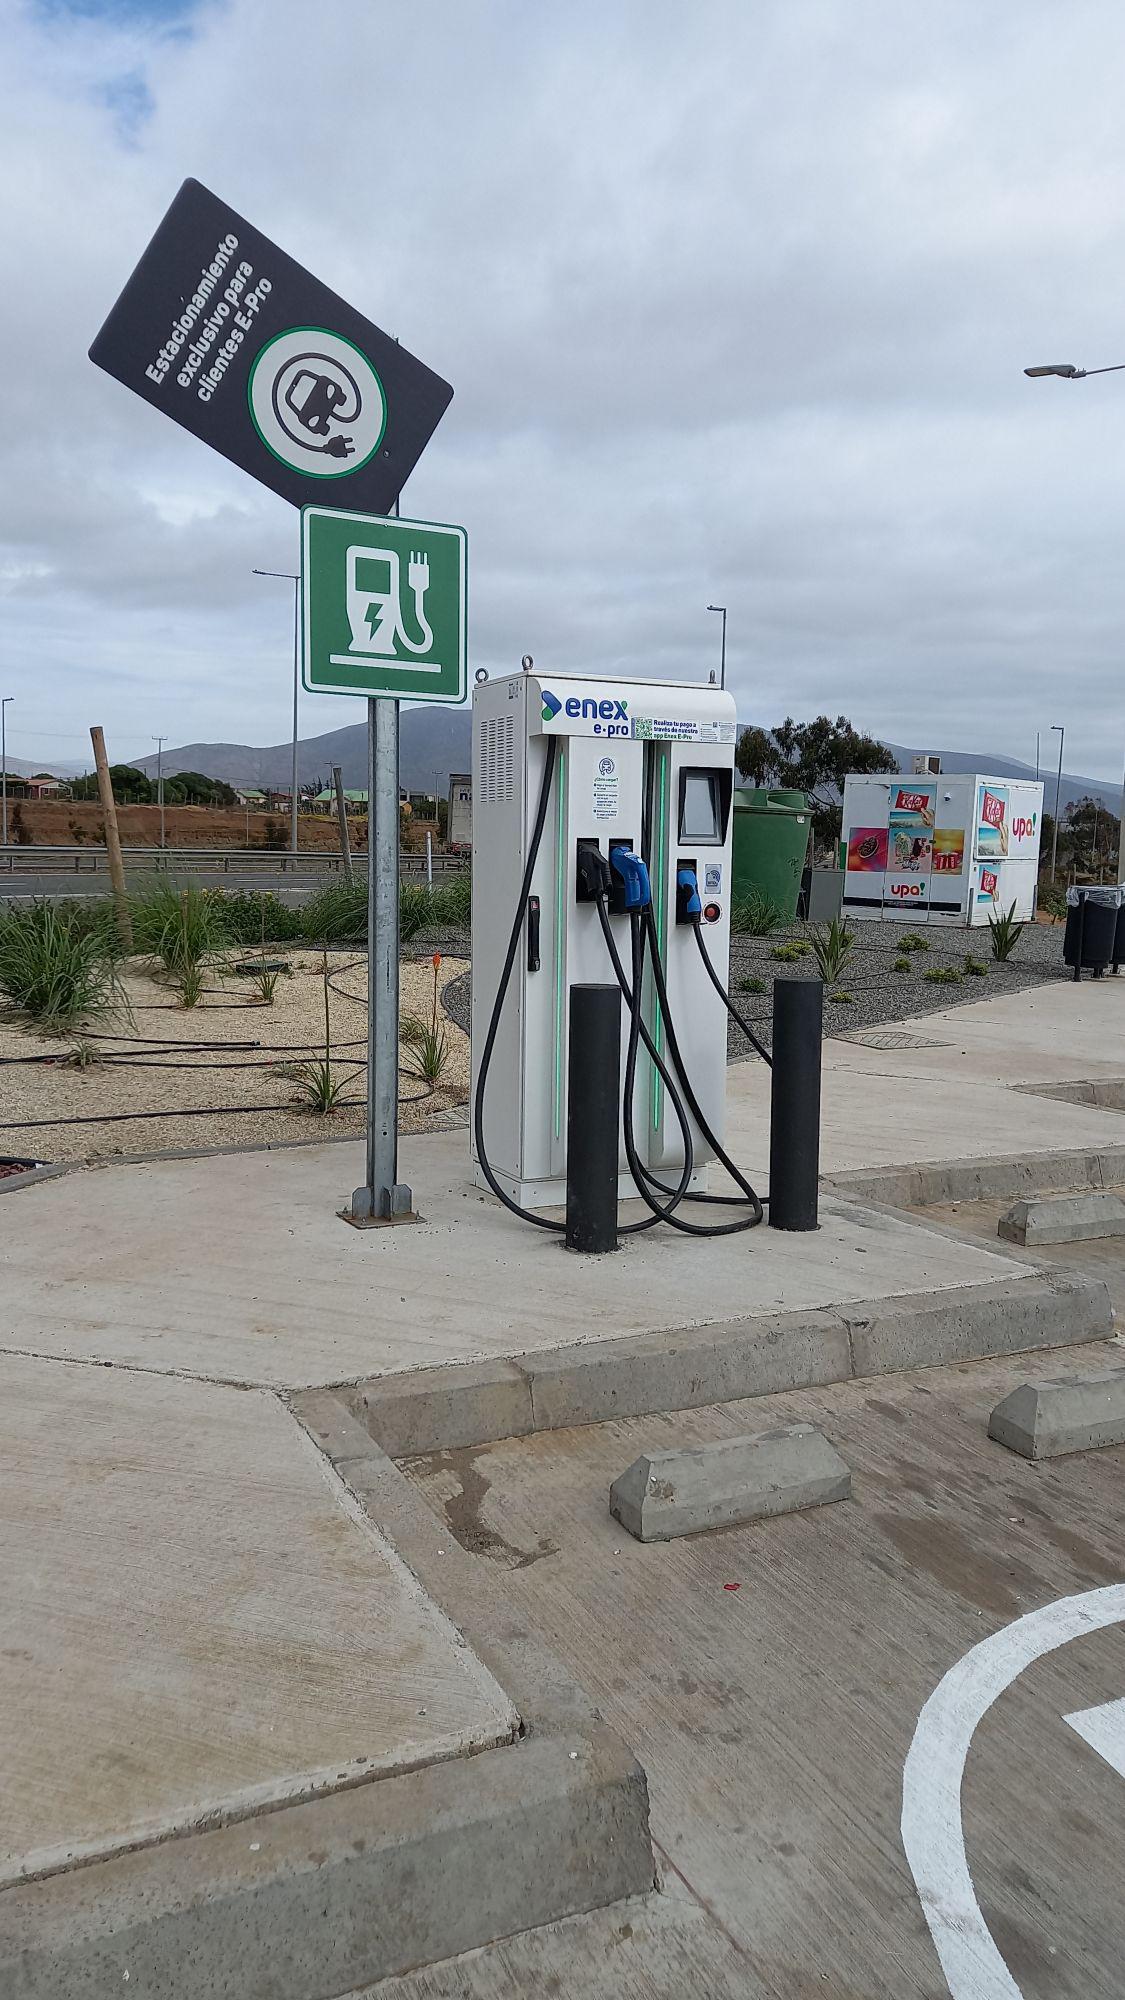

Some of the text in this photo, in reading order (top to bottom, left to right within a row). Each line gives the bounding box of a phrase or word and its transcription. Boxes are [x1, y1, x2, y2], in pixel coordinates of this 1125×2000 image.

[145, 233, 239, 385] Estacionamiento
[176, 261, 254, 388] exclusivo para
[197, 277, 273, 402] clientes E-Pro
[565, 697, 629, 721] enex
[653, 719, 673, 727] Realiza
[680, 721, 693, 729] pago
[1012, 812, 1037, 842] upa!
[891, 882, 926, 899] upa!
